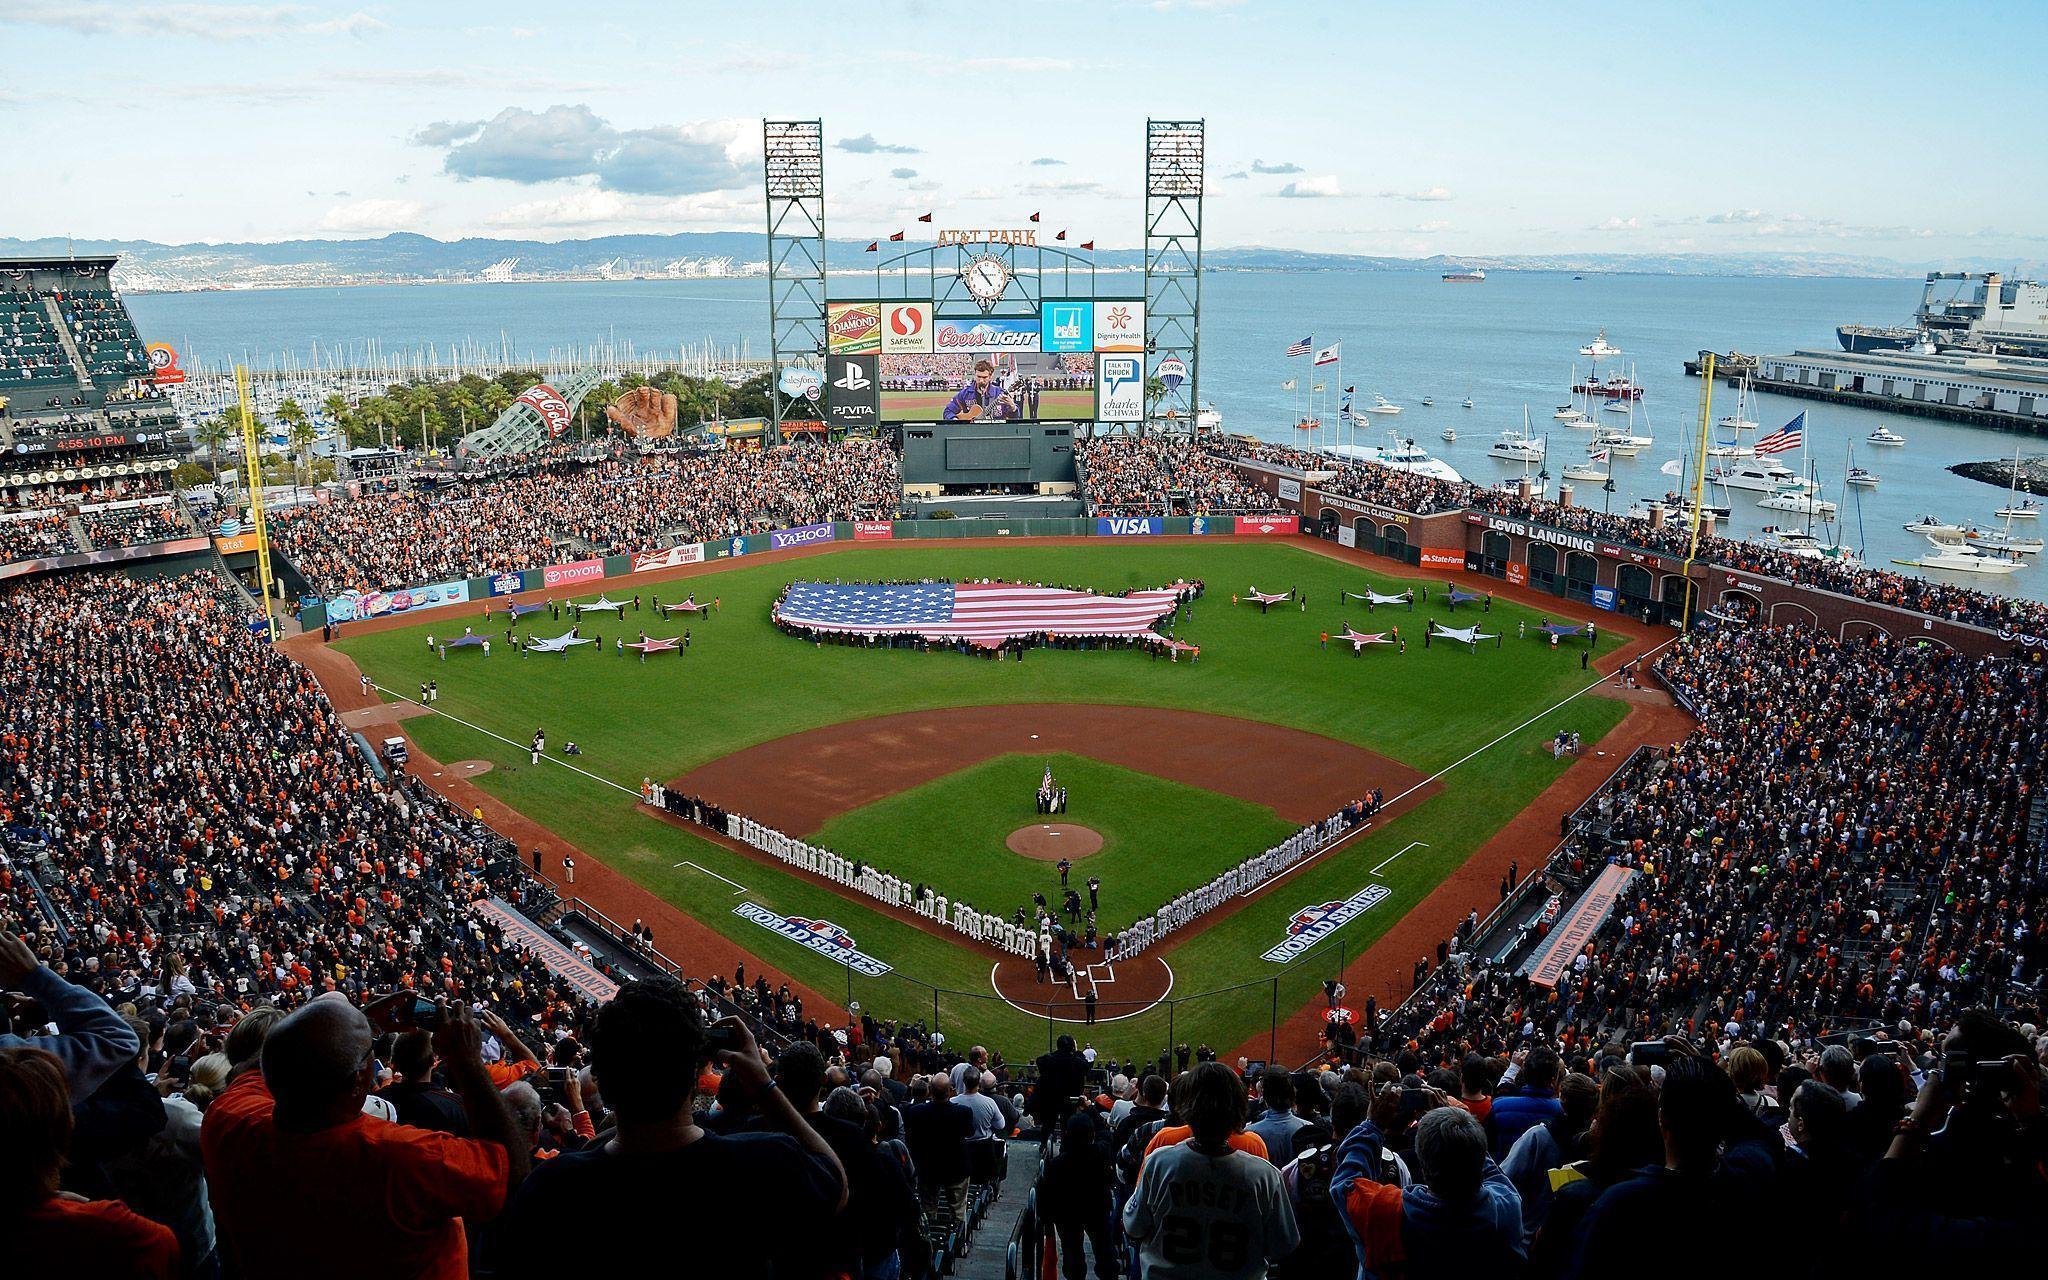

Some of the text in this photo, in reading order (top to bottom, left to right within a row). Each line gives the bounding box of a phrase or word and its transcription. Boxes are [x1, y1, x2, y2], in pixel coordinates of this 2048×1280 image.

[937, 229, 1036, 248] AT&T PARK
[833, 316, 877, 334] DIAMOND
[1055, 325, 1080, 337] PG&E
[890, 338, 924, 346] SAFEWAY
[938, 325, 1037, 347] Coors LIGHT
[1097, 332, 1120, 341] Dignity
[783, 375, 819, 388] salesforce
[1104, 399, 1139, 410] charles
[1103, 409, 1140, 417] SCHWAB
[57, 437, 102, 450] 4:55:10
[105, 435, 125, 446] PM
[1325, 496, 1410, 525] WORLD BASEBALL CLASSIC 2013
[1107, 518, 1151, 535] VISA
[1265, 516, 1292, 525] America
[773, 525, 833, 548] YAHOO!
[1528, 526, 1596, 553] LANDING
[222, 538, 244, 551] at&t
[676, 547, 690, 555] WALK
[561, 564, 602, 578] TOYOTA
[1467, 562, 1477, 571] 365
[1737, 581, 1763, 592] america
[1669, 618, 1683, 628] 309
[1265, 885, 1389, 961] WORLD SERIES
[737, 902, 889, 975] WORLD SERIES
[1538, 893, 1610, 981] WELCOME TO AT&T PARK
[511, 926, 572, 968] FRANCISCO
[563, 964, 616, 997] GIANTS
[1163, 1215, 1250, 1272] 28
